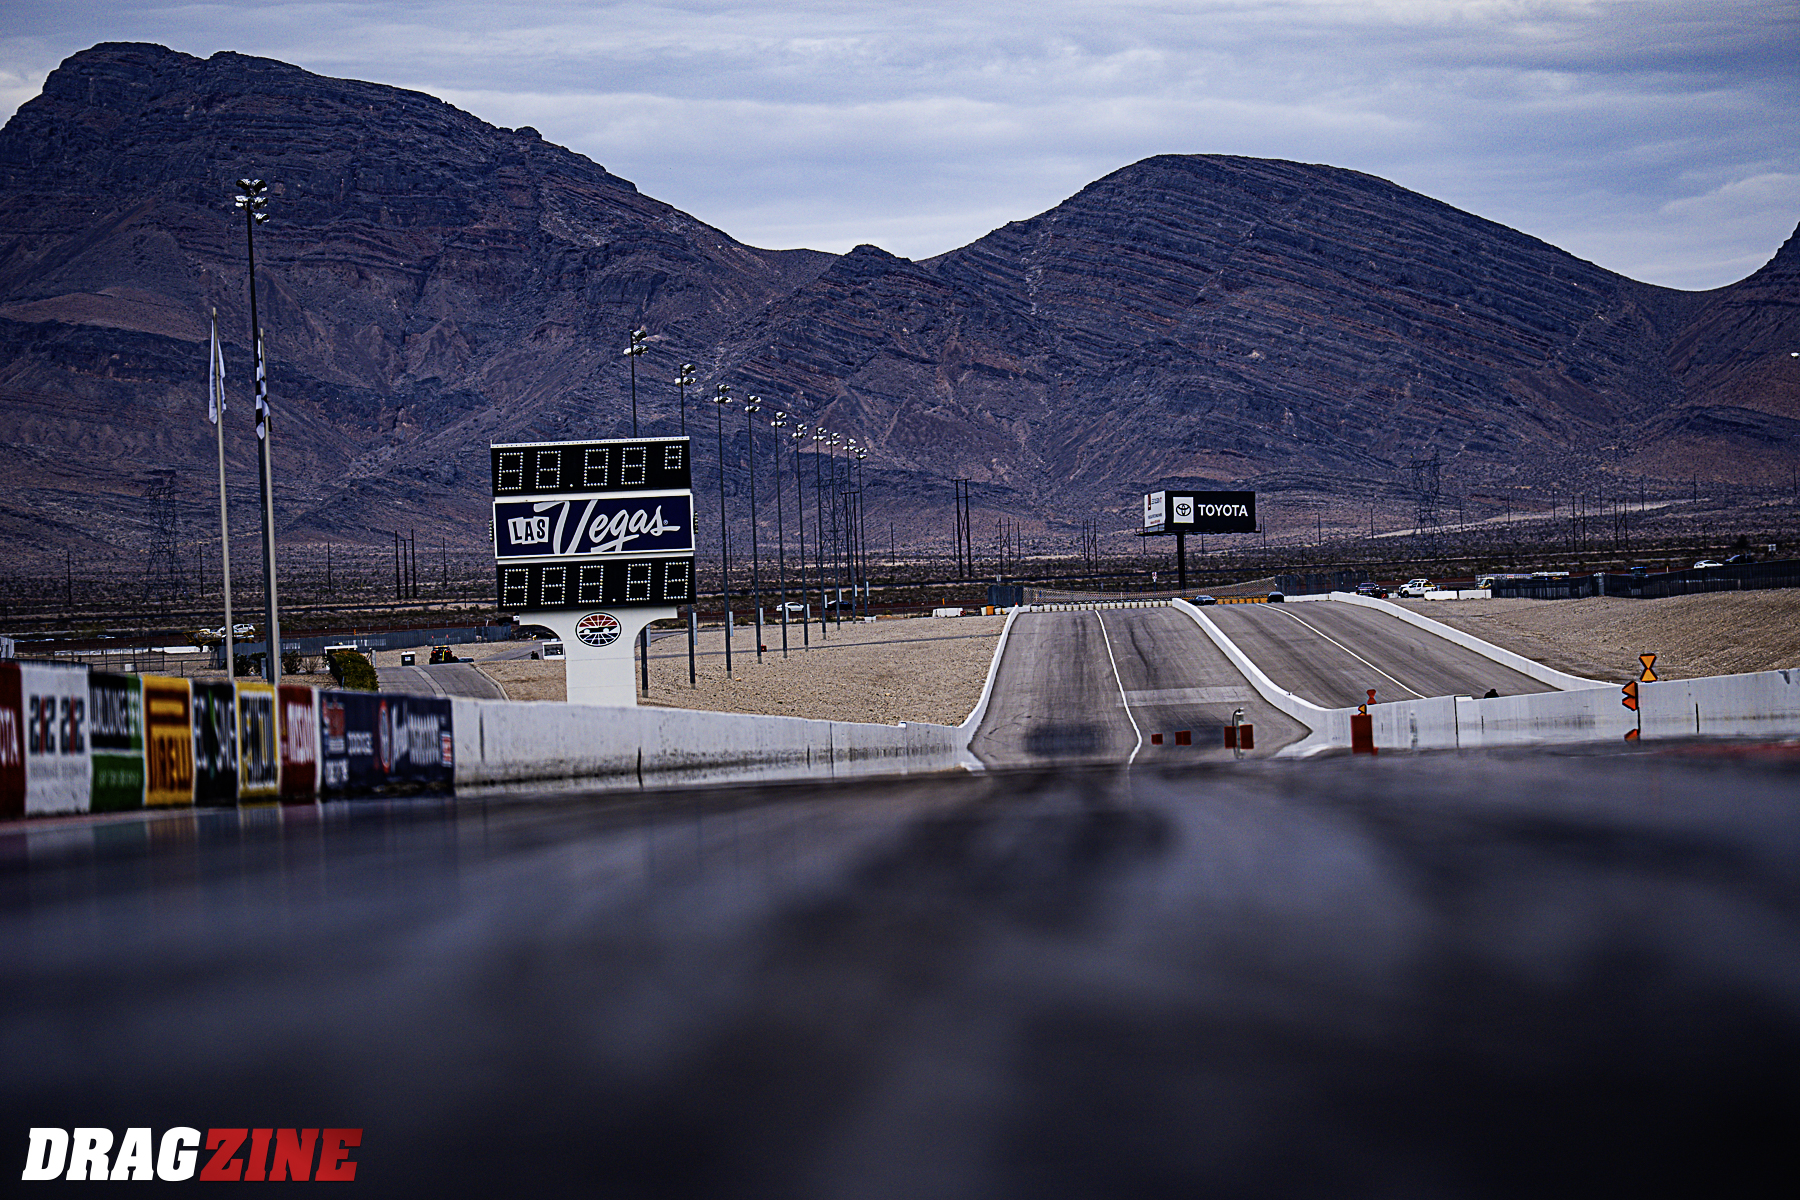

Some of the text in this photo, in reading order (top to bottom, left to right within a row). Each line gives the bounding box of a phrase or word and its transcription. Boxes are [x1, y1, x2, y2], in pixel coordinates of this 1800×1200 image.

[510, 499, 681, 554] LAS Vegas
[1197, 504, 1249, 517] TOYOTA
